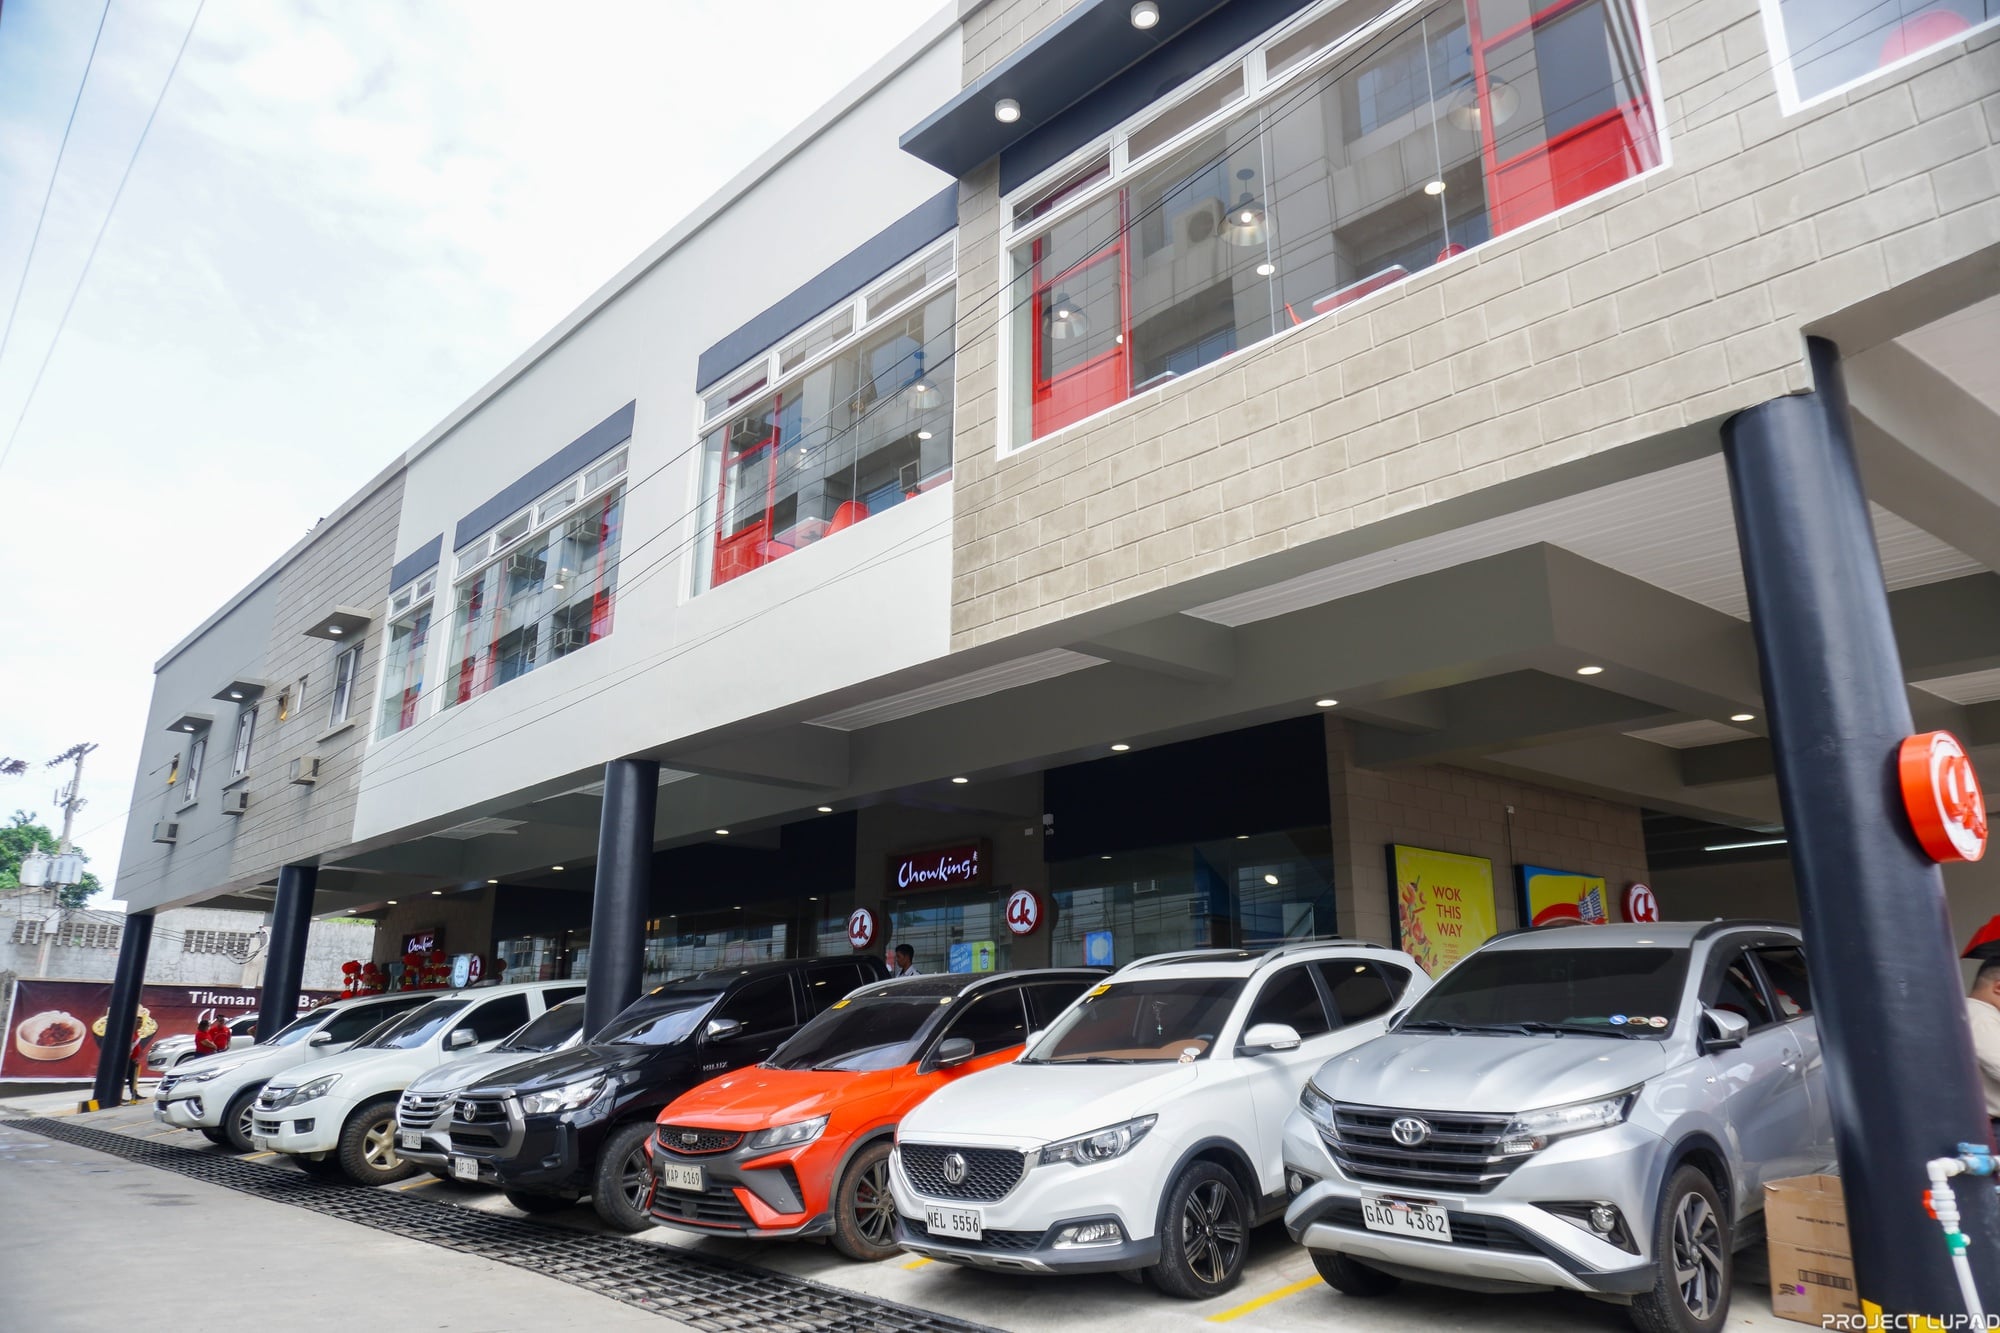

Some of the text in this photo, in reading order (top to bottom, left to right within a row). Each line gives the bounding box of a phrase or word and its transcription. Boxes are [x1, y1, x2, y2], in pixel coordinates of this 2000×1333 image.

[898, 856, 971, 887] Chowking
[1432, 885, 1462, 901] WOK
[1008, 897, 1033, 926] Ck
[1436, 904, 1462, 920] THIS
[1437, 922, 1463, 938] WAY
[189, 990, 318, 1008] Tikman Ba
[666, 1169, 700, 1185] KAP 6169
[927, 1211, 979, 1233] NEL 5556
[1365, 1205, 1447, 1233] GAO 4382
